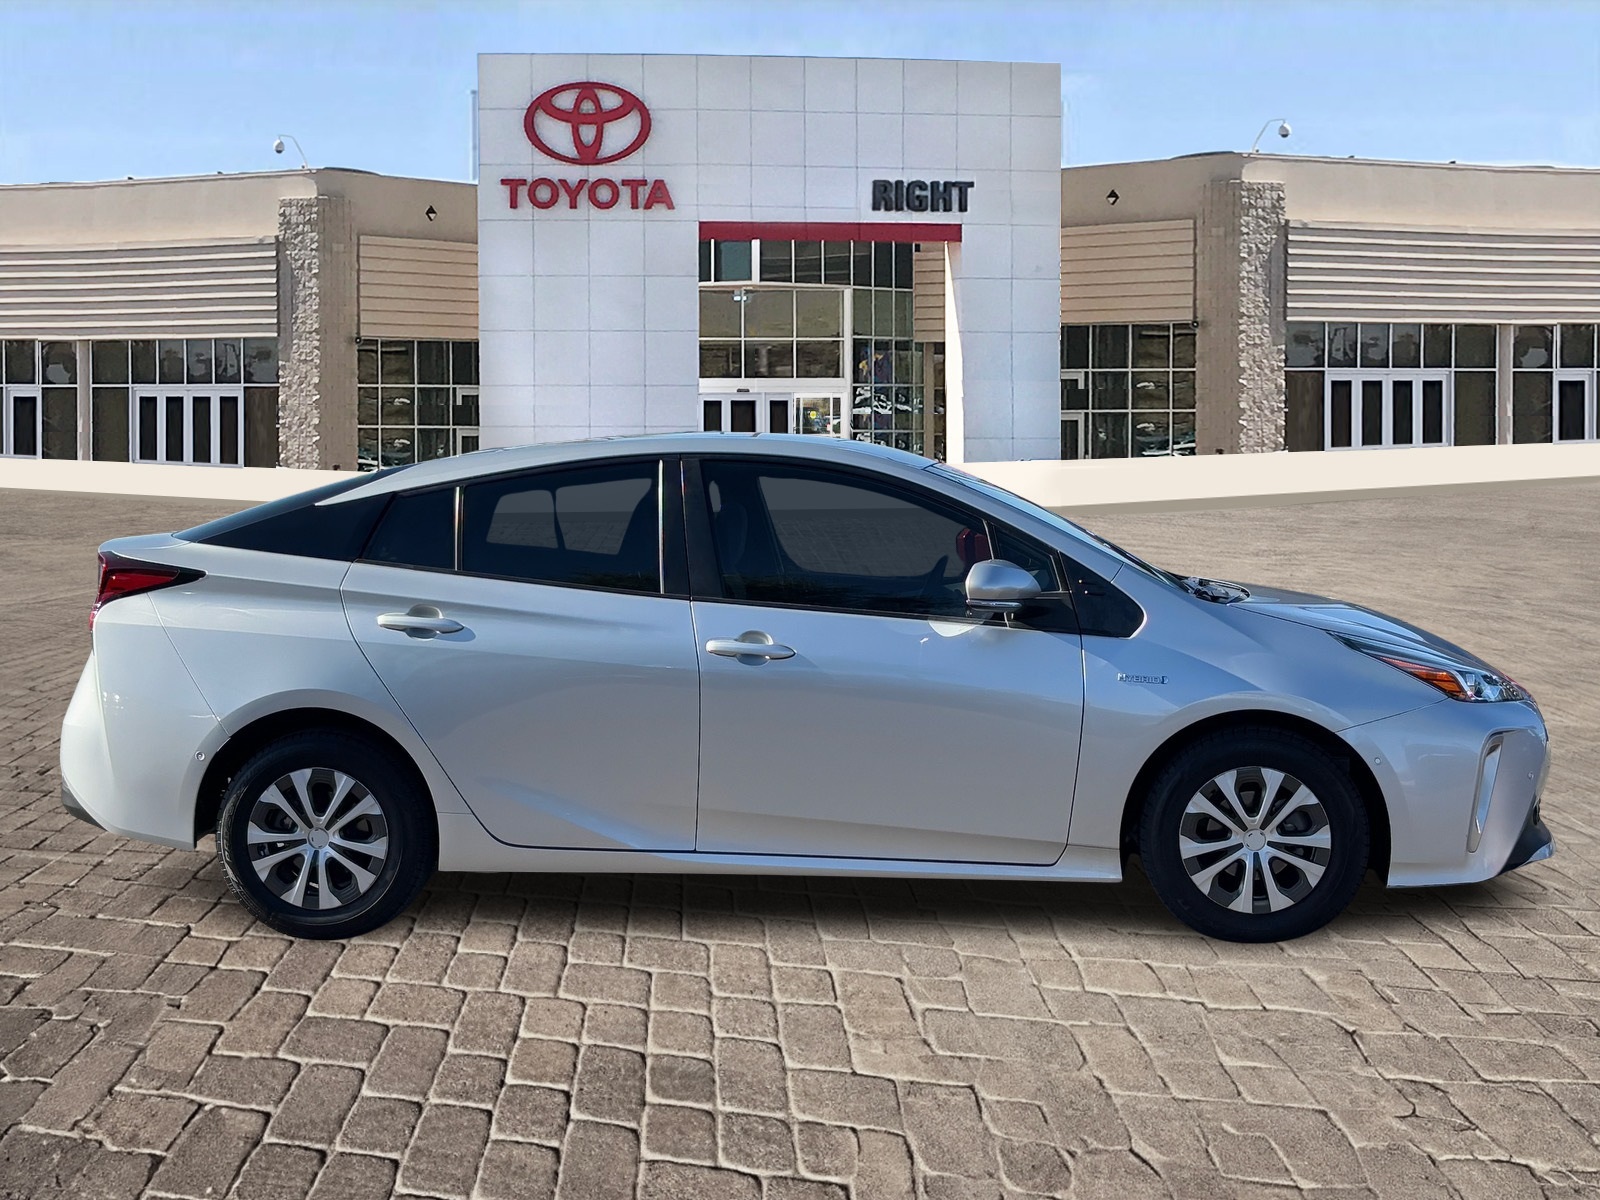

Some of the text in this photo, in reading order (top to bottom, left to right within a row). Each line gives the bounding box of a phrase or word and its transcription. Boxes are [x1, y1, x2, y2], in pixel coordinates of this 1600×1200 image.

[500, 179, 675, 210] TOYOTA
[872, 180, 975, 213] RIGHT
[1117, 672, 1161, 685] HYBRID
